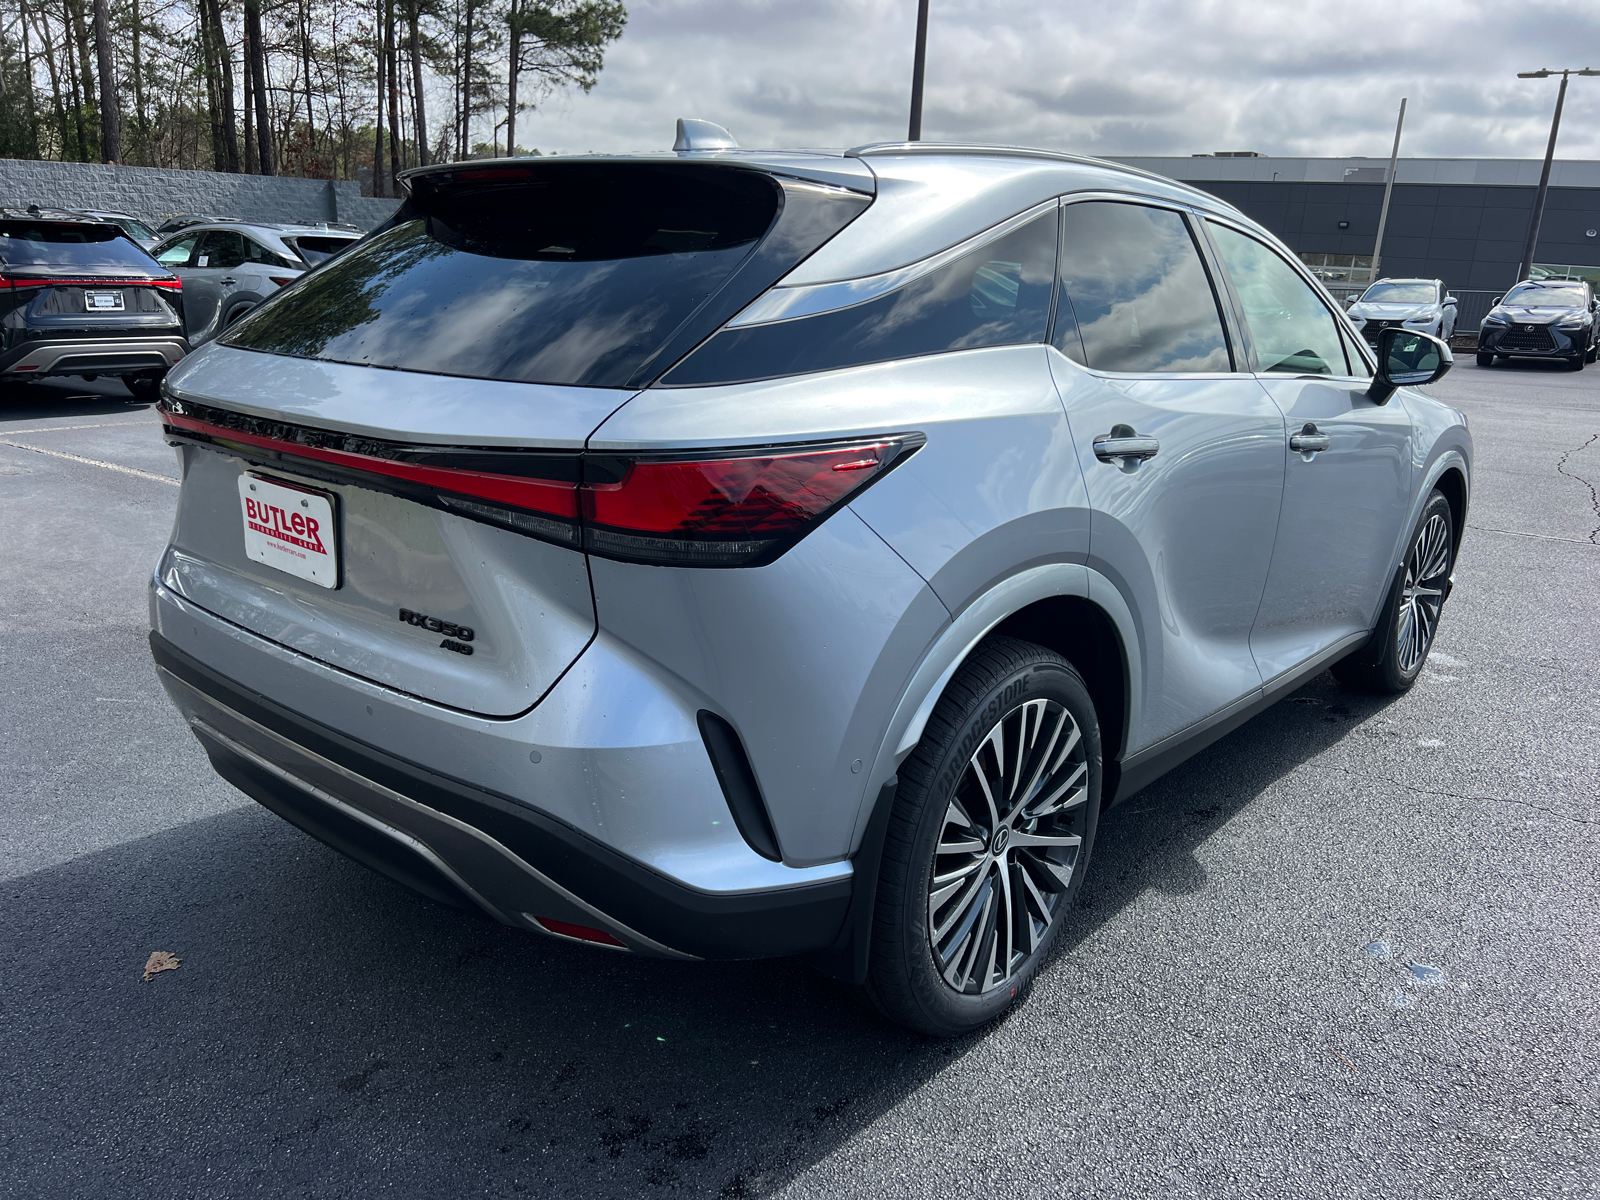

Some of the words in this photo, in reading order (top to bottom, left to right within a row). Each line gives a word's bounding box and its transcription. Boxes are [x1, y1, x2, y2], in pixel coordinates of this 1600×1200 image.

[398, 607, 475, 642] RX350
[439, 638, 474, 656] AWD
[936, 674, 1030, 799] BRIDGESTONE
